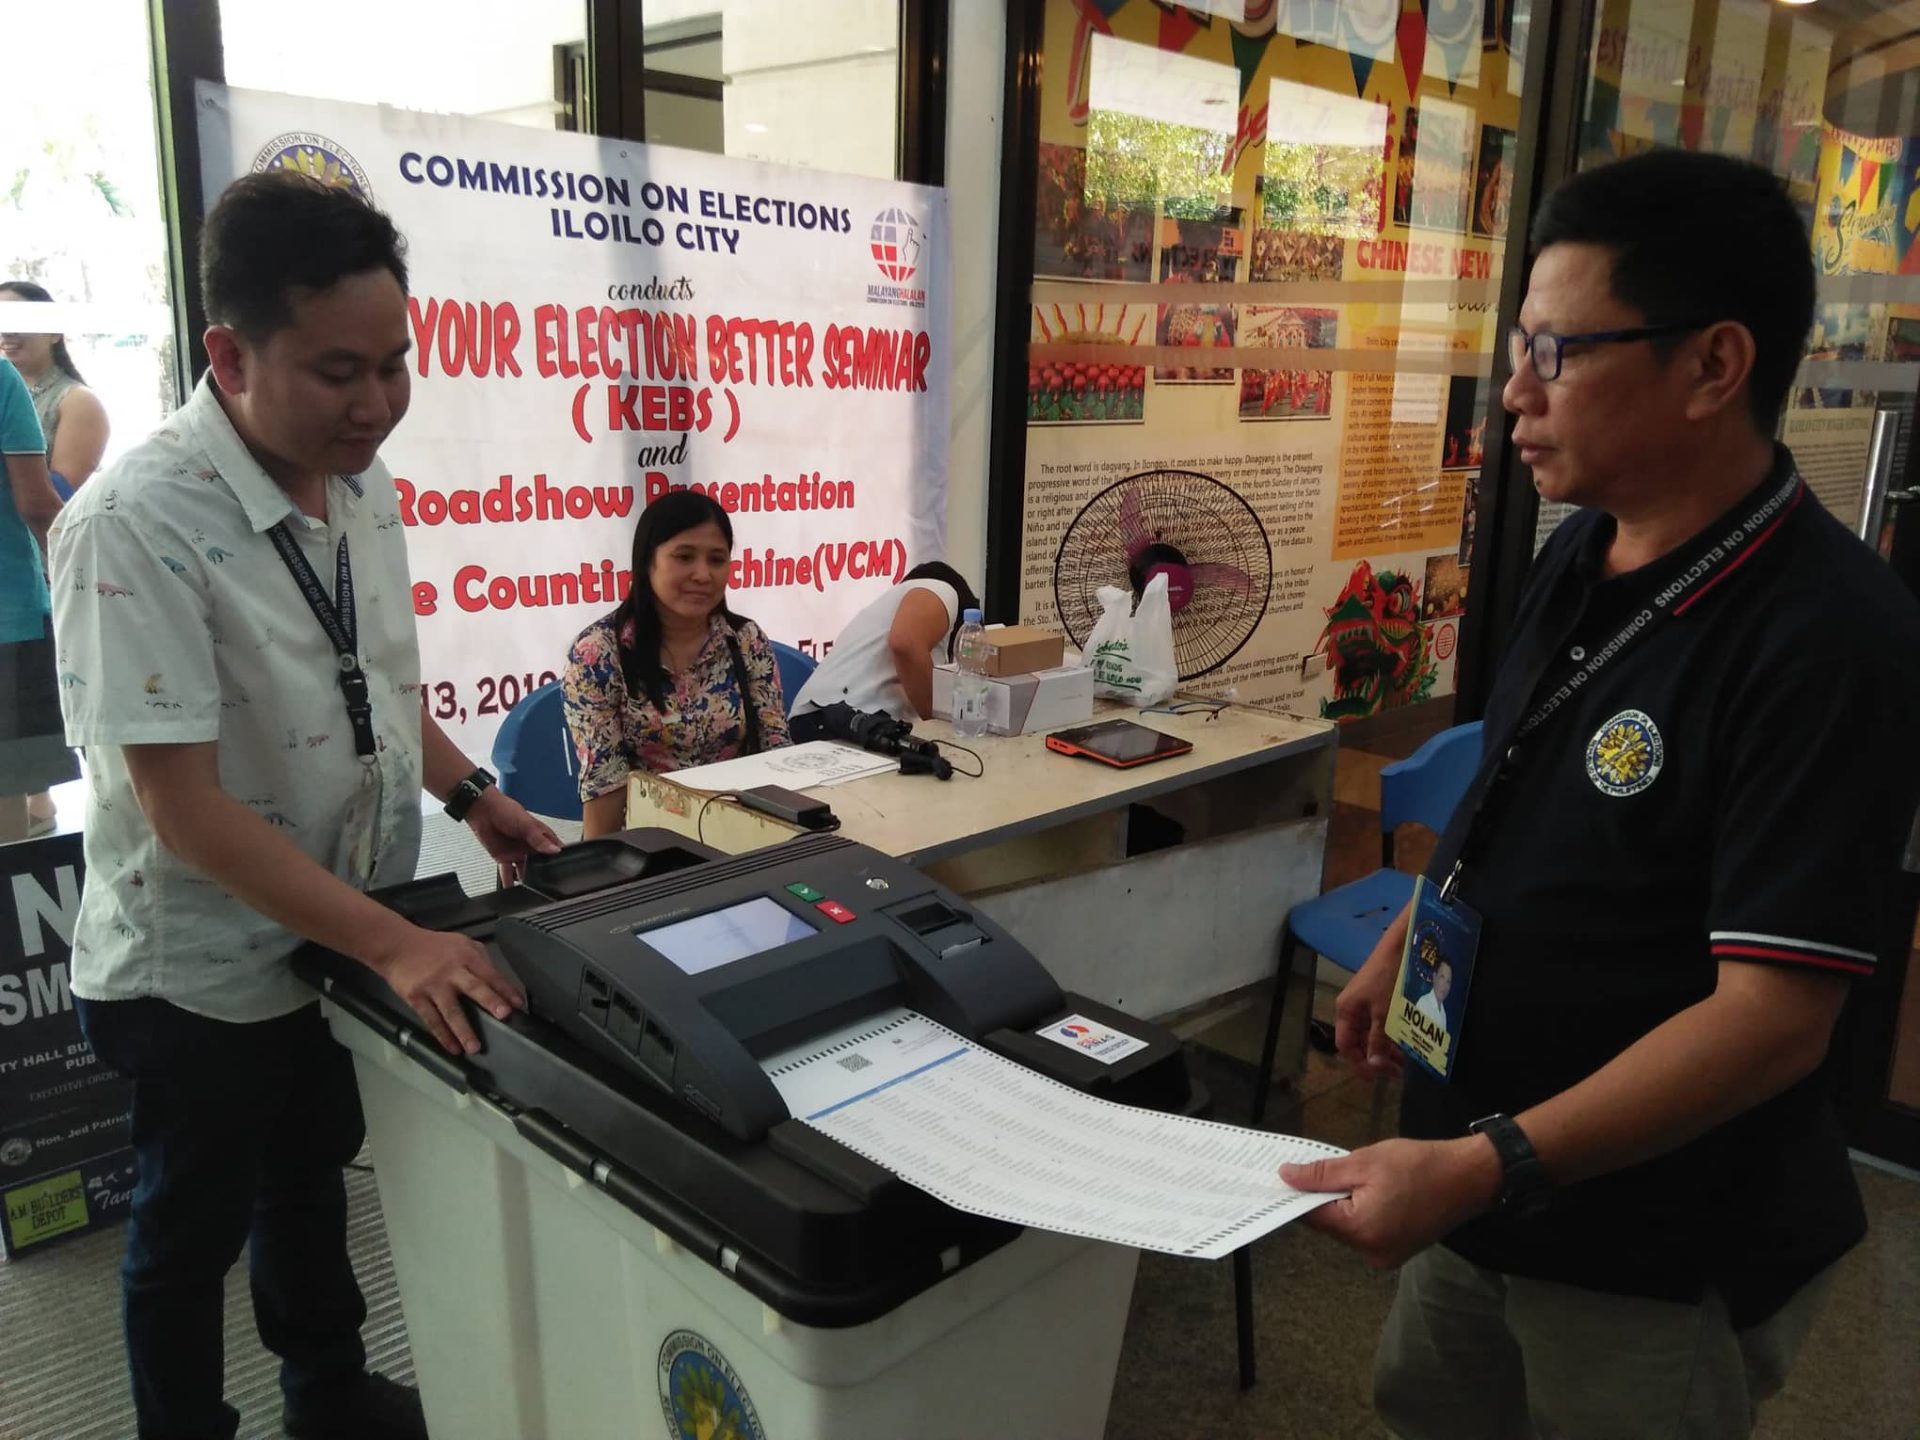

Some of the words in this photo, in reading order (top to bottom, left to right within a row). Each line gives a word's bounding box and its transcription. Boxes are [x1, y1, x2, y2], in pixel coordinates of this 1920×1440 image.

[304, 135, 320, 146] ON
[399, 152, 631, 207] COMMISSION
[641, 182, 689, 214] ON
[699, 190, 851, 234] ELECTIONS
[550, 208, 665, 247] ILOILO
[676, 222, 740, 254] CITY
[1357, 239, 1444, 275] CHINESE
[1451, 248, 1493, 279] NEW
[608, 276, 695, 301] conducts
[408, 297, 522, 379] YOUR
[534, 305, 698, 382] ELECTION
[706, 314, 813, 388] BETTER
[822, 323, 931, 392] SEMINAR
[608, 385, 713, 432] KEBS
[637, 433, 688, 467] and
[1041, 463, 1054, 474] The
[1056, 463, 1071, 473] root
[1074, 462, 1091, 472] word
[1093, 462, 1099, 471] is
[1177, 457, 1197, 467] means
[1199, 457, 1205, 466] to
[1207, 456, 1222, 466] make
[1245, 454, 1275, 466] Dinagyang
[1277, 453, 1281, 462] is
[1282, 452, 1291, 462] the
[1293, 451, 1312, 463] present
[1028, 480, 1070, 492] progressive
[1072, 477, 1090, 488] word
[1092, 476, 1100, 486] of
[1101, 475, 1112, 485] the
[1213, 469, 1231, 480] merry
[1284, 464, 1293, 474] The
[1294, 464, 1323, 475] Dinagyang
[1028, 495, 1033, 504] is
[1042, 494, 1073, 505] religious
[1075, 491, 1088, 500] and
[1242, 480, 1251, 489] the
[1253, 478, 1271, 489] fourth
[1272, 477, 1292, 488] Sunday
[1293, 476, 1299, 485] of
[393, 474, 634, 527] Roadshow
[1026, 522, 1044, 532] Niño
[1046, 521, 1060, 531] and
[1062, 521, 1070, 529] to
[1298, 501, 1304, 509] of
[1305, 500, 1314, 508] the
[1027, 510, 1035, 518] or
[1037, 508, 1054, 520] right
[1056, 507, 1073, 517] after
[1256, 491, 1269, 500] both
[1270, 490, 1276, 499] to
[1278, 490, 1295, 498] honor
[1295, 489, 1304, 497] the
[1743, 472, 1799, 532] COMMISSION
[1026, 536, 1048, 547] island
[1049, 536, 1057, 545] to
[1281, 515, 1296, 523] came
[1297, 513, 1304, 521] to
[1305, 512, 1313, 520] the
[1026, 551, 1047, 562] island
[1289, 526, 1305, 535] peace
[1722, 530, 1744, 550] ON
[1025, 564, 1053, 576] offering
[1273, 538, 1280, 548] of
[1281, 537, 1289, 546] the
[1290, 537, 1306, 545] datus
[1306, 536, 1313, 544] to
[273, 525, 311, 587] COMMISSION
[308, 584, 321, 599] ON
[315, 599, 348, 650] ELECTIONS
[341, 565, 350, 580] ON
[1025, 580, 1047, 590] barter
[1035, 602, 1041, 611] It
[1043, 601, 1048, 609] is
[1290, 567, 1306, 575] honor
[1307, 564, 1314, 573] of
[1654, 546, 1725, 608] ELECTIONS
[1024, 617, 1036, 627] the
[1037, 615, 1051, 625] Sto.
[1276, 582, 1283, 591] by
[1284, 580, 1293, 588] the
[1292, 601, 1303, 610] and
[1585, 609, 1653, 674] COMMISSION
[1186, 683, 1199, 693] from
[1201, 681, 1211, 690] the
[1212, 678, 1231, 688] mouth
[1231, 675, 1238, 684] of
[1239, 673, 1249, 682] the
[1250, 670, 1262, 679] river
[1263, 666, 1284, 676] towards
[1285, 664, 1293, 673] the
[1226, 660, 1252, 674] Devotees
[1252, 657, 1275, 668] carrying
[1276, 652, 1298, 663] assorted
[1292, 688, 1304, 698] local
[1569, 671, 1588, 689] ON
[1404, 1002, 1445, 1048] NOLAN
[23, 1049, 63, 1067] HALL
[29, 1079, 84, 1101] EXECUTIVE
[36, 1136, 65, 1148] Hon.
[68, 1124, 89, 1139] Jed
[32, 1205, 67, 1229] DEPOT
